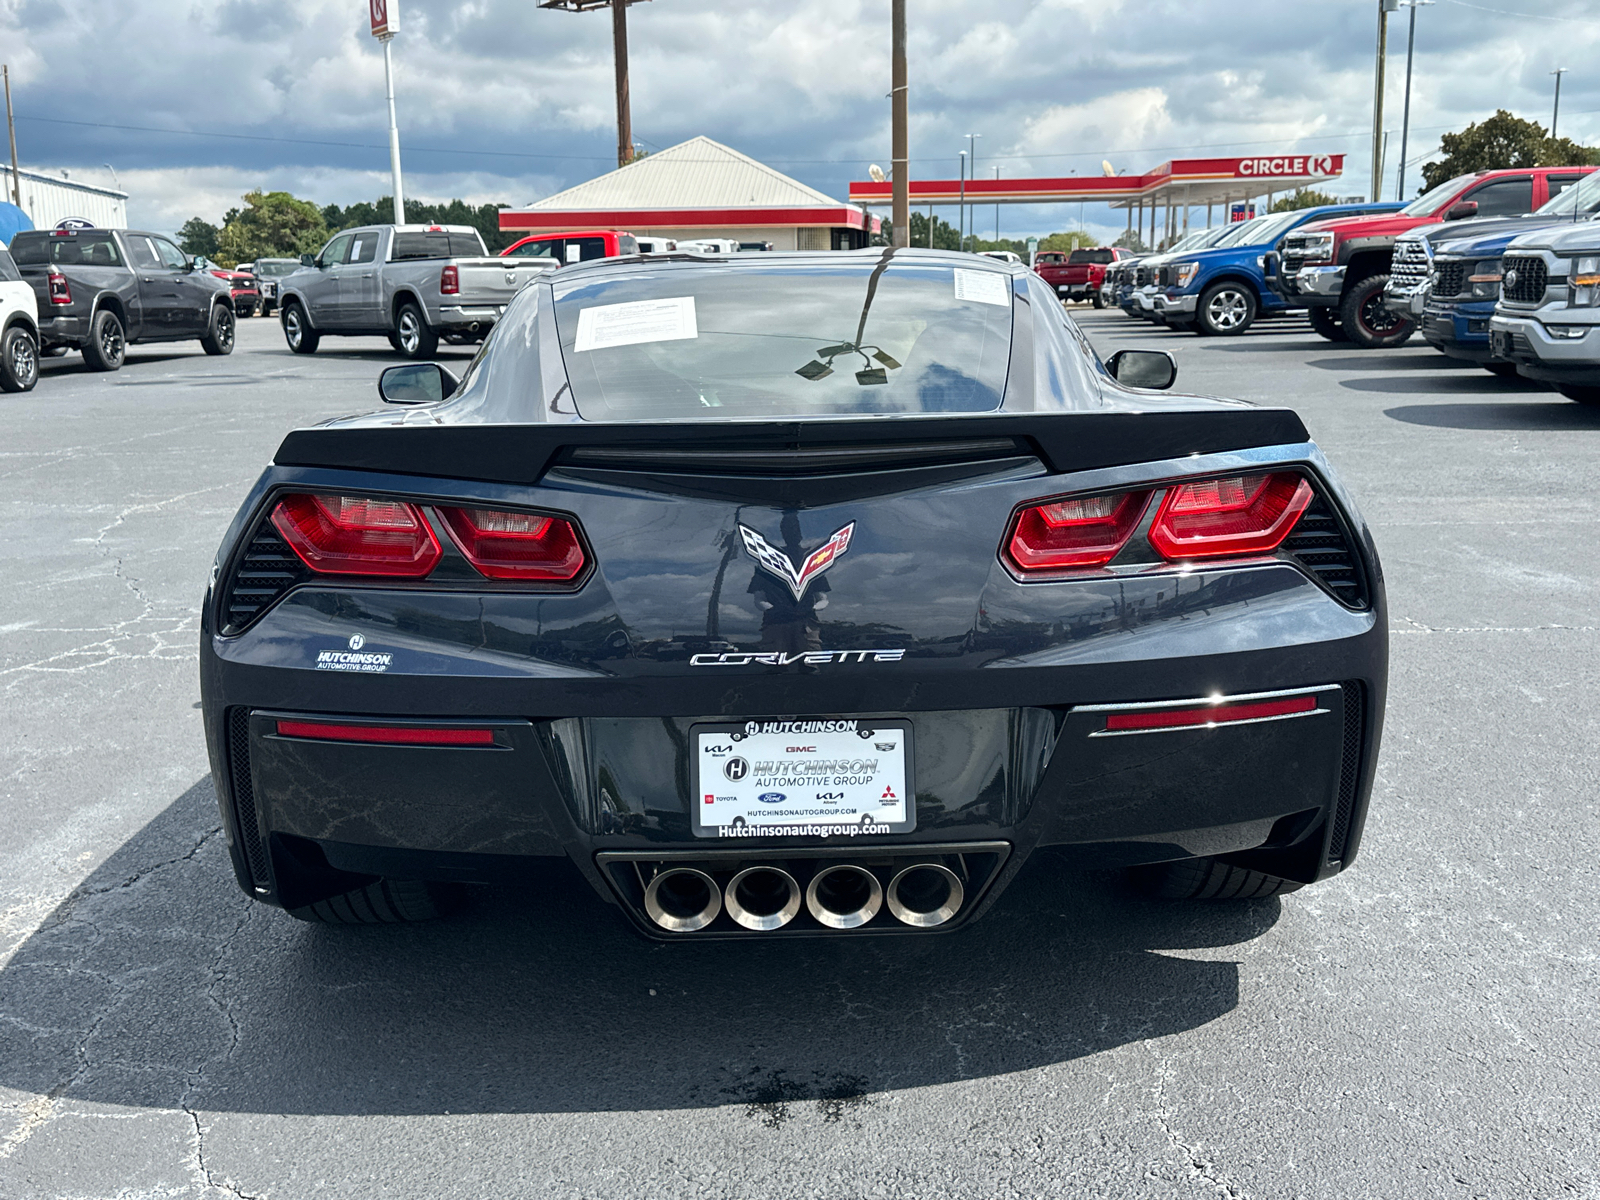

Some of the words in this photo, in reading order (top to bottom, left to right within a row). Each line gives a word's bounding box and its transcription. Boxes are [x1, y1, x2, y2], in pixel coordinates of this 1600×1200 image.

[1239, 158, 1304, 175] CIRCLE
[317, 652, 391, 665] HUTCHINSON
[690, 649, 906, 666] CORVETTE
[317, 662, 361, 671] AUTOMOTIVE
[361, 664, 386, 672] GROUP
[762, 720, 858, 734] HUTCHINSON
[753, 759, 878, 776] HUTCHINSON
[755, 777, 830, 787] AUTOMOTIVE
[833, 776, 873, 786] GROUP
[747, 808, 857, 817] HUTCHINSONAUTOGROUP.COM
[718, 824, 890, 838] Hutchinsonautogroup.com
